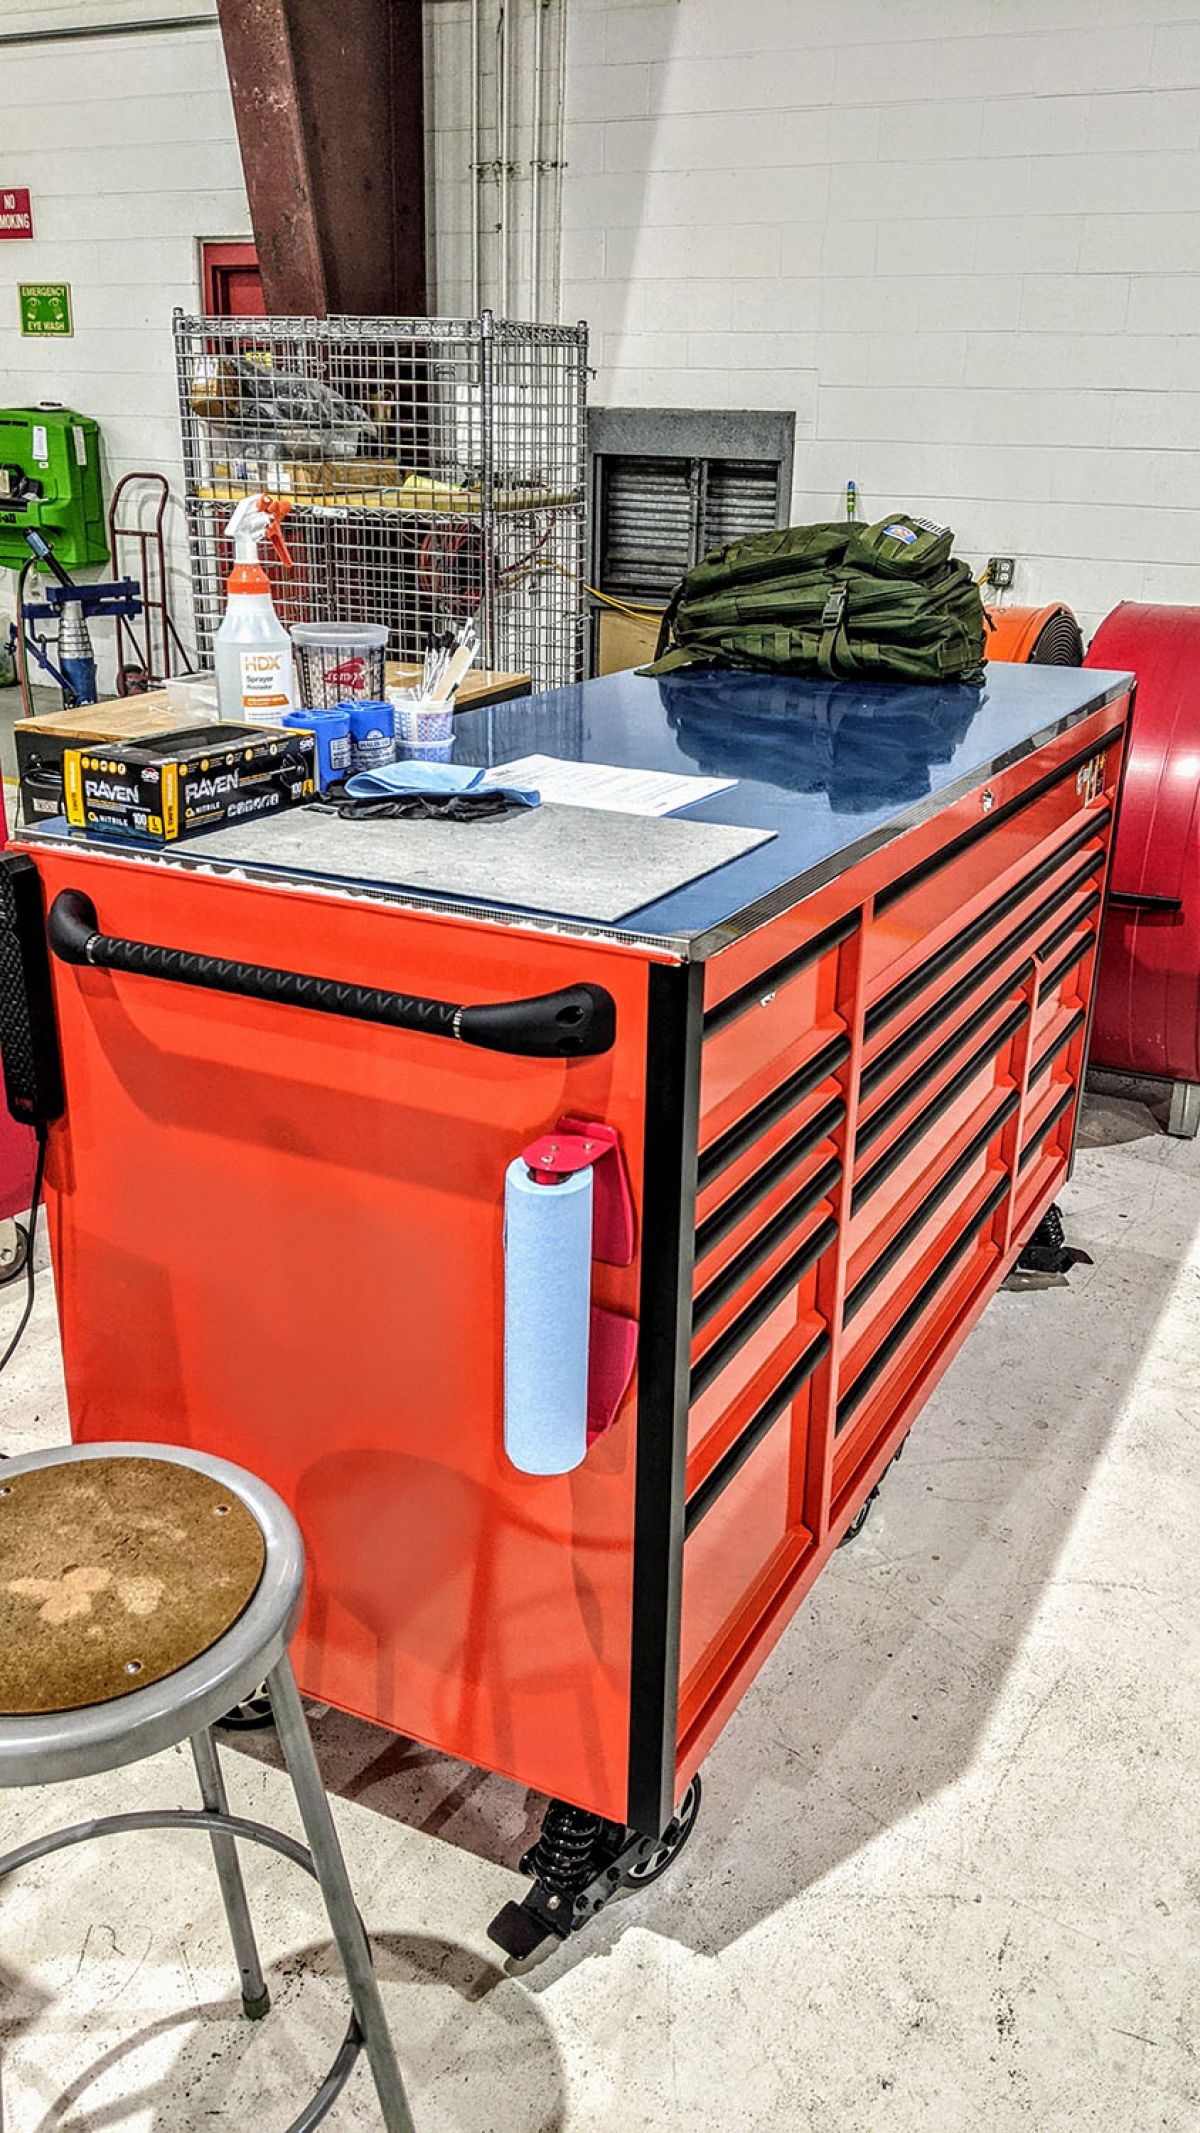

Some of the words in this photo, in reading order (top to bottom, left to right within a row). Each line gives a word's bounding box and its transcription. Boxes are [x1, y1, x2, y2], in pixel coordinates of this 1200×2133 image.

[3, 194, 15, 209] NO
[0, 213, 30, 229] MOKING
[22, 287, 65, 296] EMERGENCY
[27, 321, 42, 330] EYE
[44, 321, 64, 331] WASH
[244, 655, 282, 671] HDX
[85, 780, 139, 803] RAVEN
[185, 767, 239, 804] RAVEN
[99, 814, 128, 827] NITRILE
